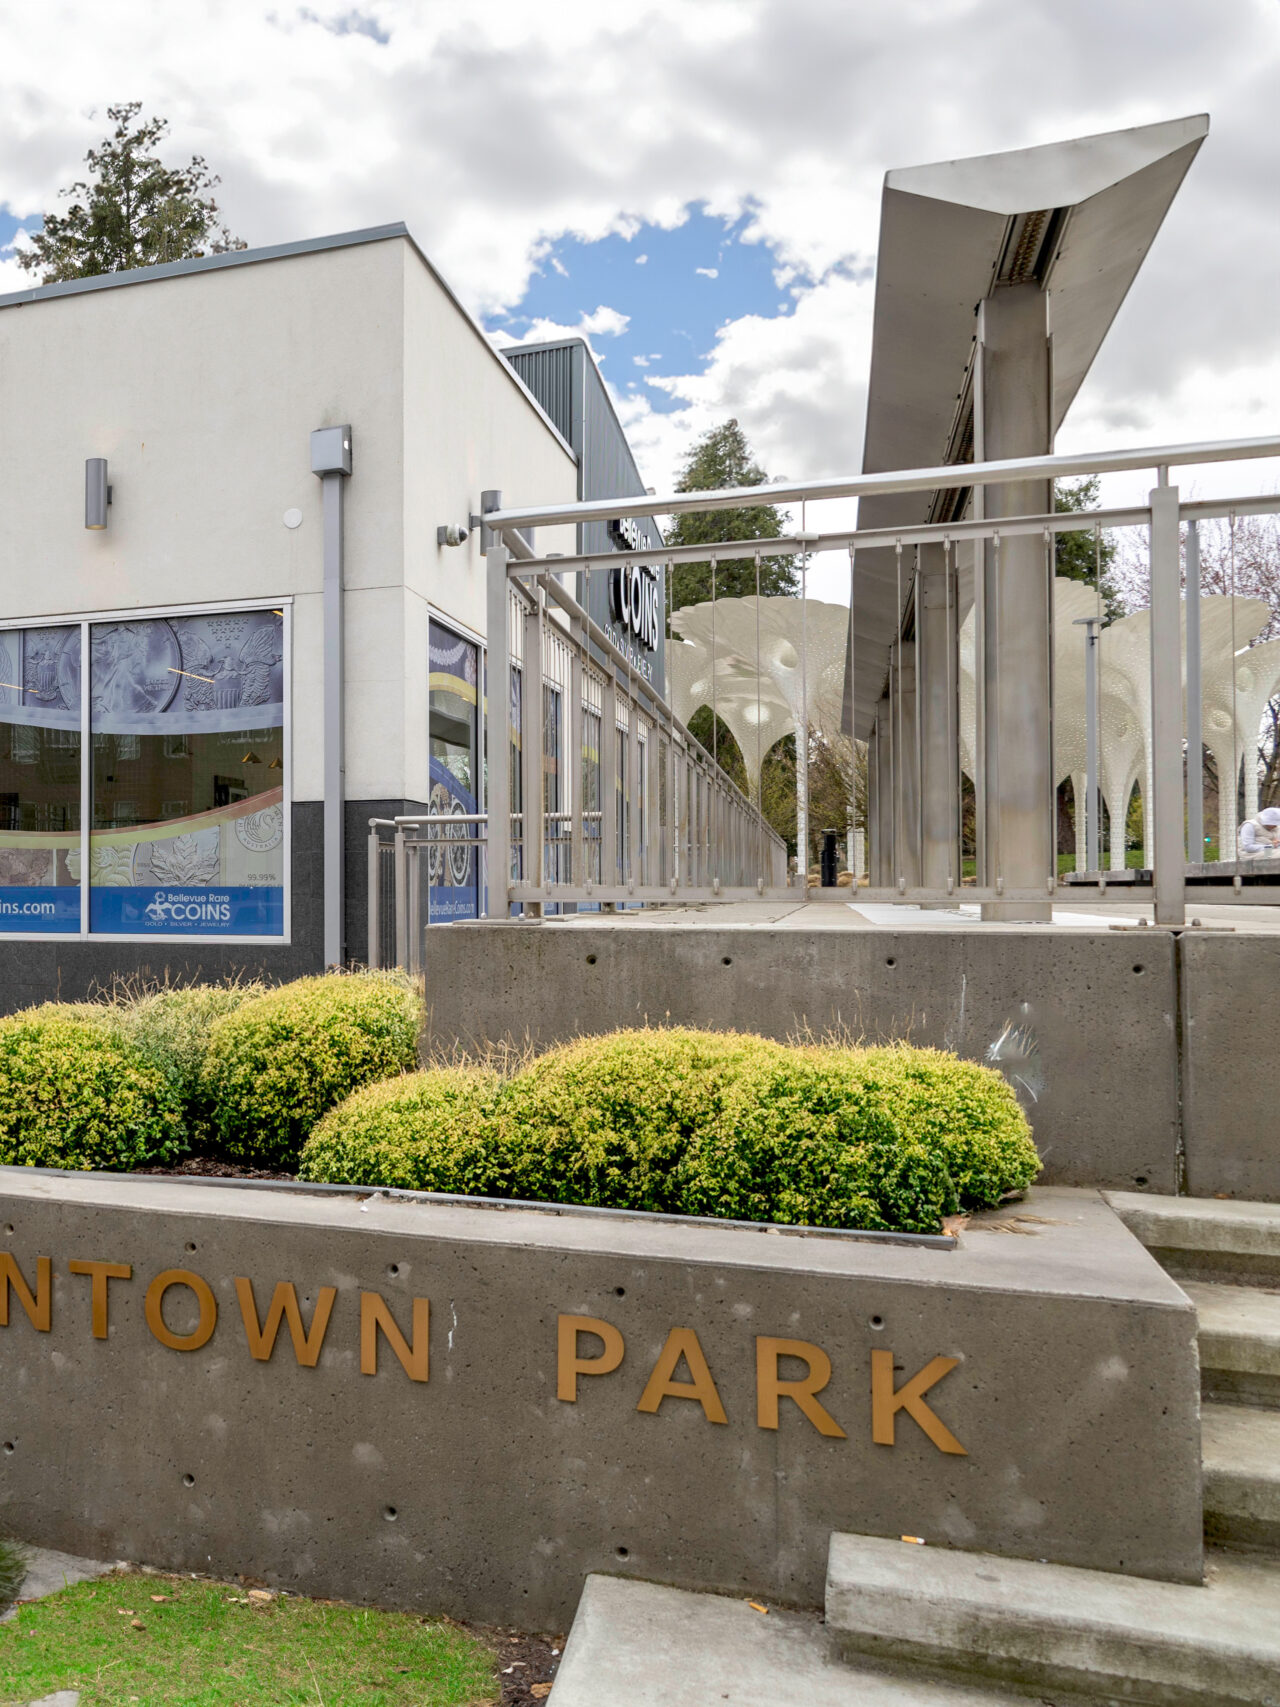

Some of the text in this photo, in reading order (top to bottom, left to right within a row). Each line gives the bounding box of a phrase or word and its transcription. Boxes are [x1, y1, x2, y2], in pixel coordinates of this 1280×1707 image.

[247, 873, 277, 881] 99.99%
[168, 893, 230, 902] Bellevue Rare
[171, 903, 231, 920] COINS
[556, 1314, 969, 1456] PARK
